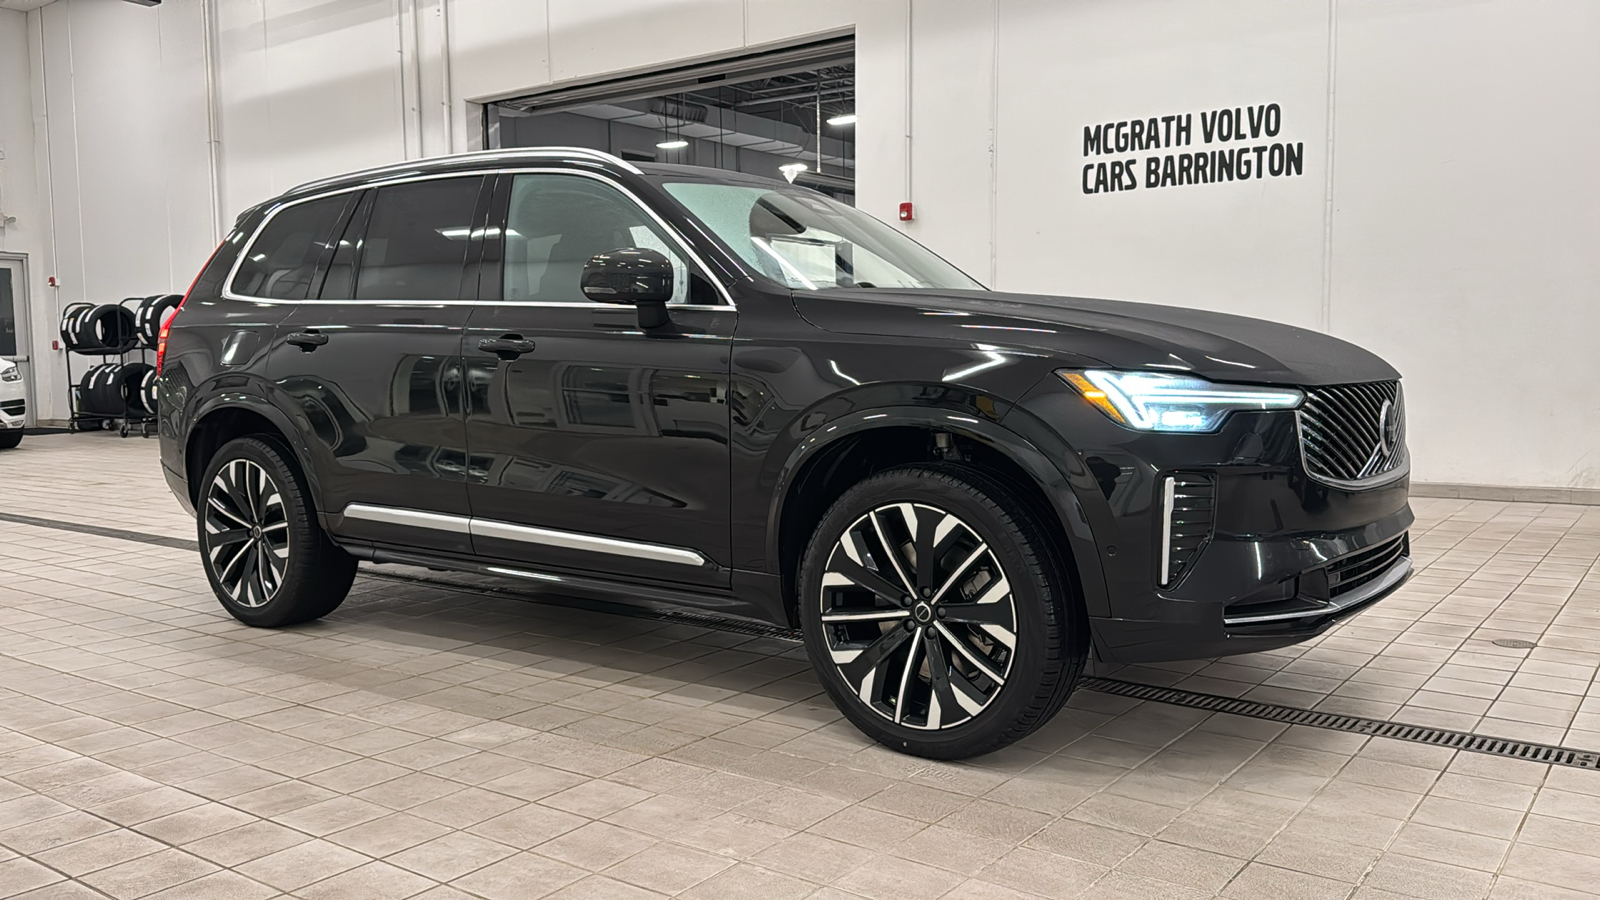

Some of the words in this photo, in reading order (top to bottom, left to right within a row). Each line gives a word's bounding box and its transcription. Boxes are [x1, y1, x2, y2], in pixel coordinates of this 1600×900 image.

[1084, 113, 1192, 157] MCGRATH
[1200, 103, 1281, 144] VOLVO
[1082, 159, 1138, 195] CARS
[1145, 142, 1304, 189] BARRINGTON
